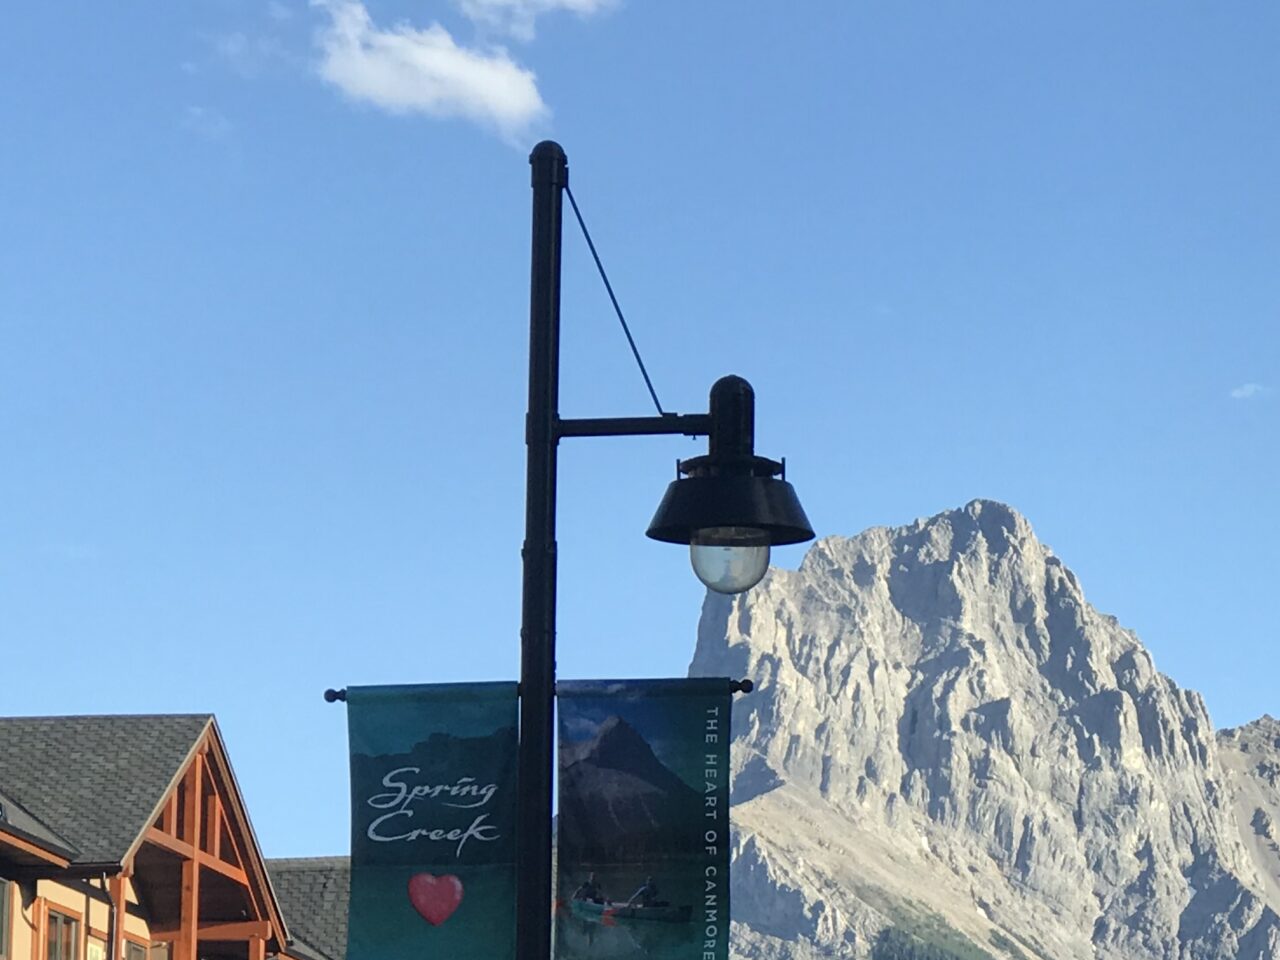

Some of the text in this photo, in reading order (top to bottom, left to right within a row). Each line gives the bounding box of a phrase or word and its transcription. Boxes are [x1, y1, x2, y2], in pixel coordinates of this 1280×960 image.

[706, 707, 719, 744] THE
[366, 766, 499, 811] Spring
[704, 754, 718, 820] HEART
[366, 810, 501, 858] Creek
[704, 830, 717, 857] OF
